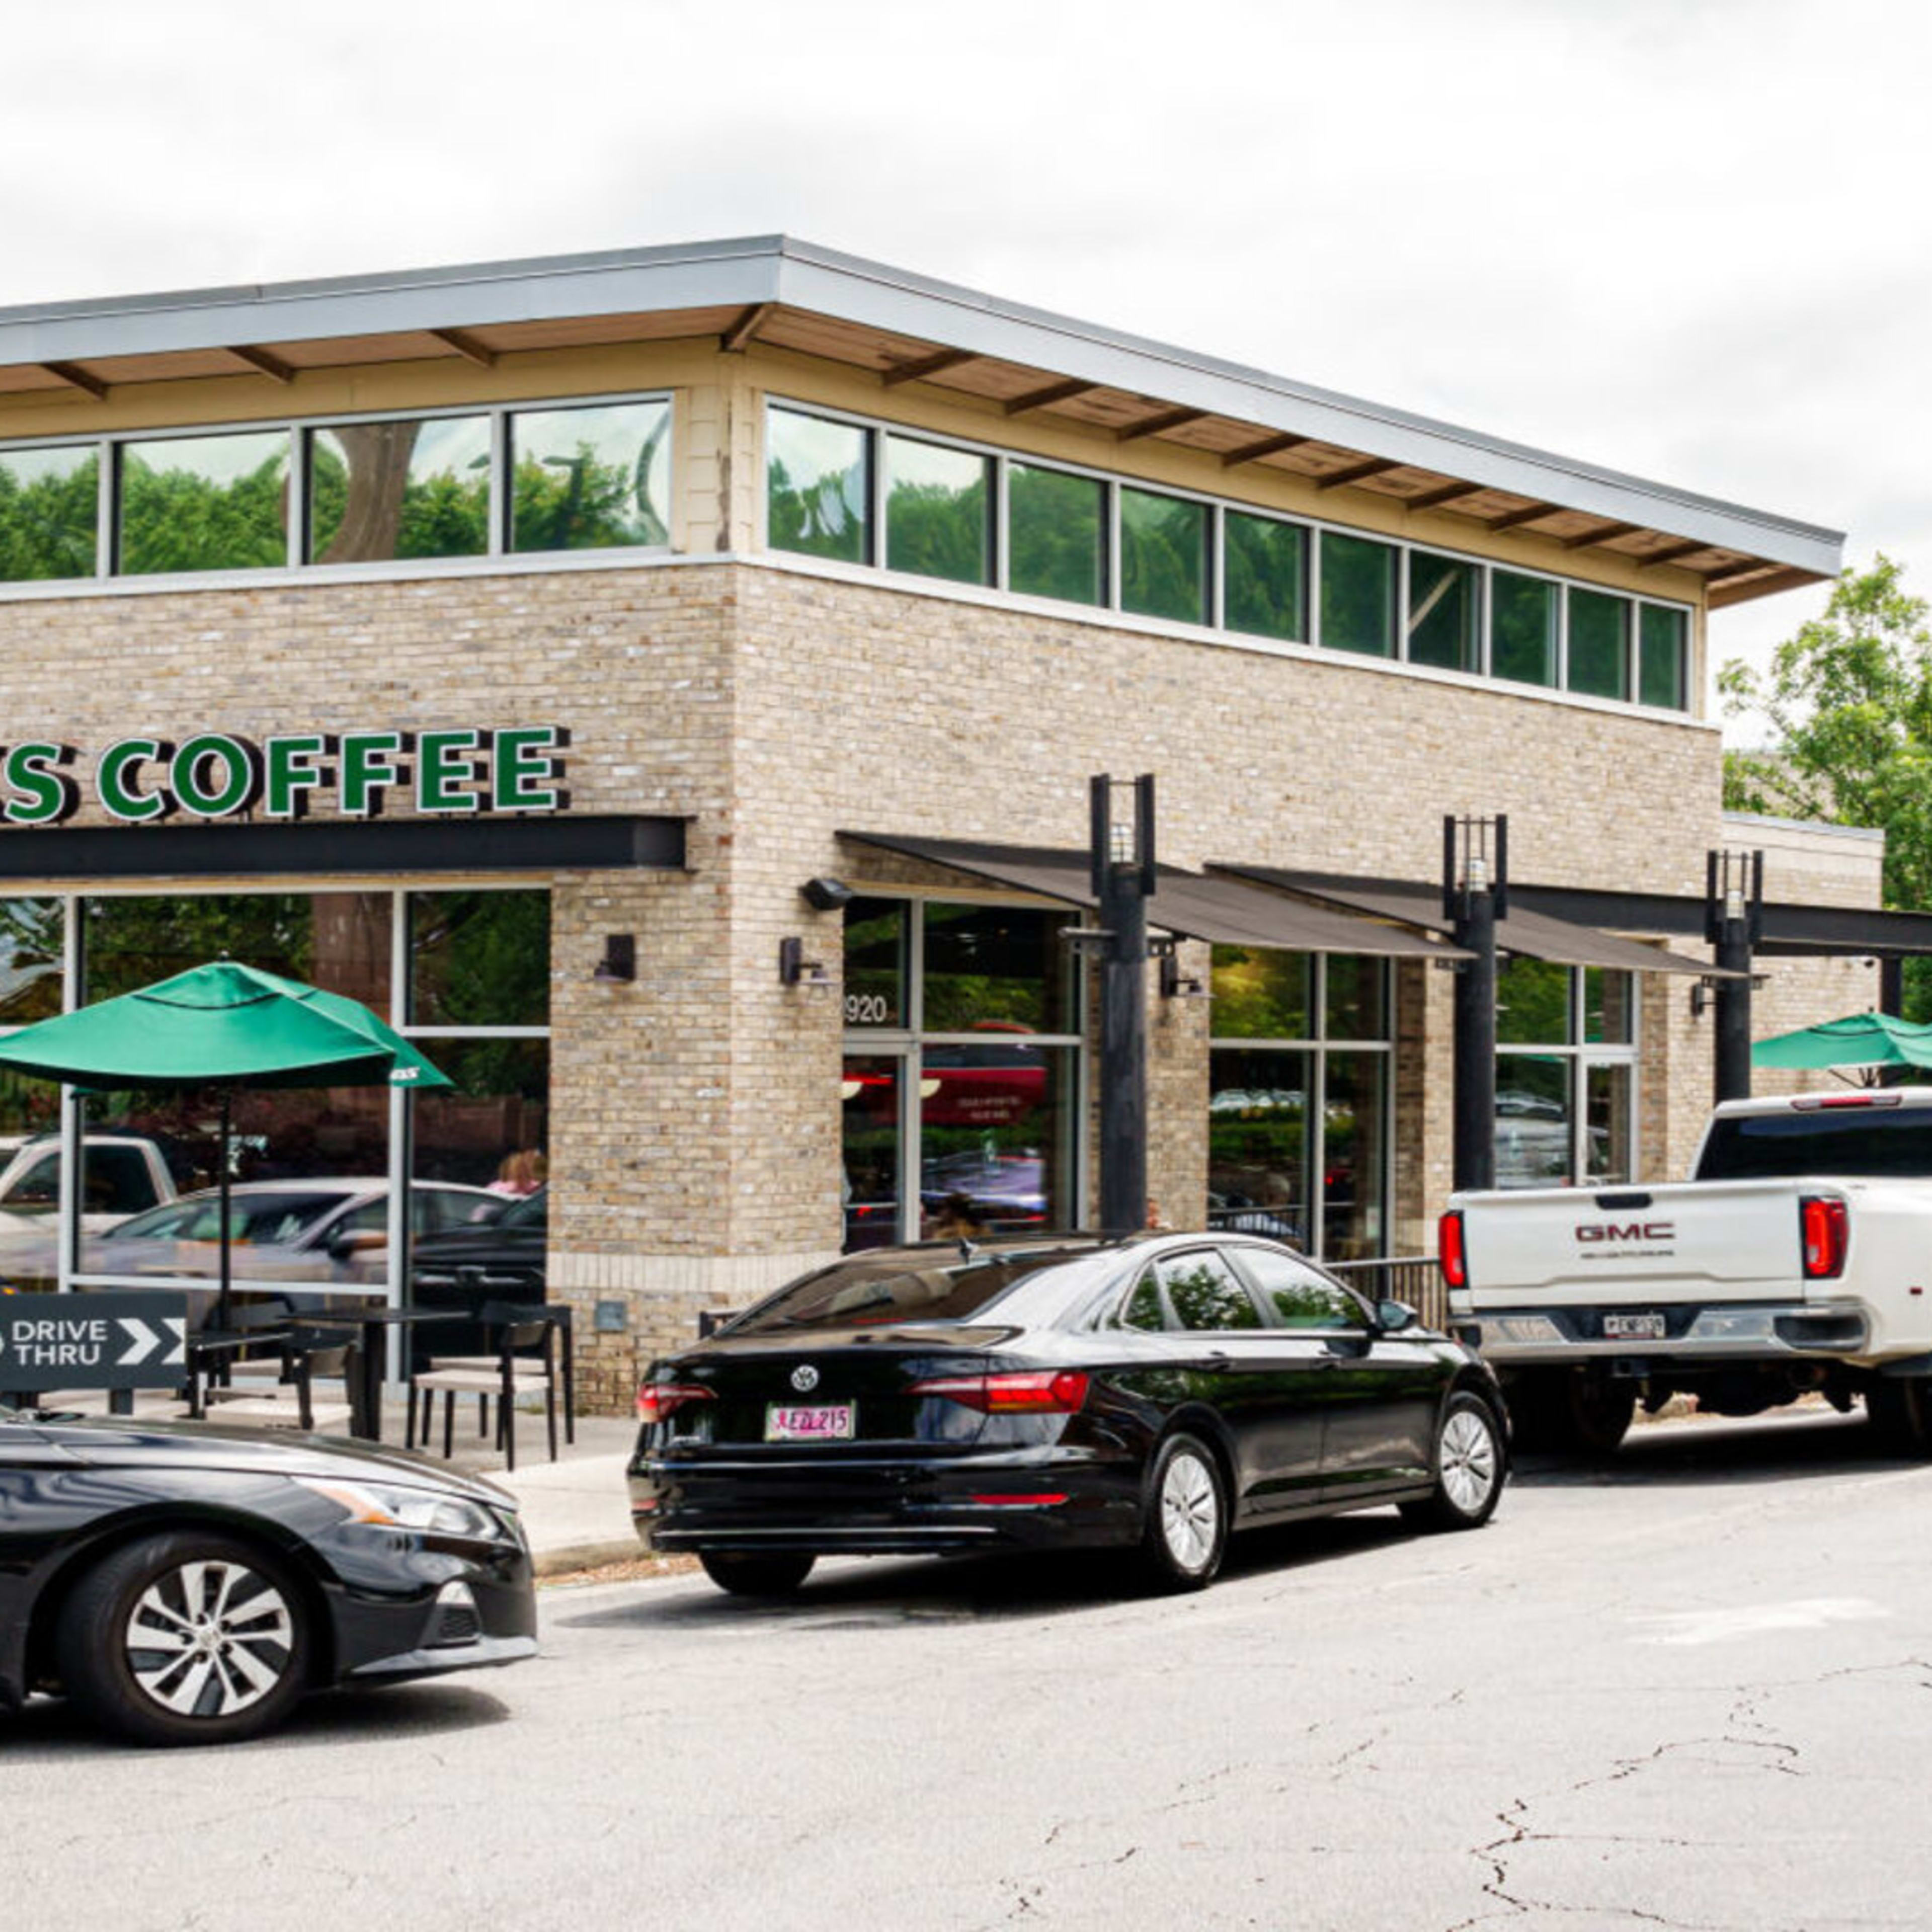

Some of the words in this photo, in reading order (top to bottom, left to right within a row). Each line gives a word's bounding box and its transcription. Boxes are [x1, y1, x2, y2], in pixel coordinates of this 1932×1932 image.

[98, 726, 558, 821] COFFEE
[1576, 1223, 1675, 1242] GMC
[12, 1320, 108, 1341] DRIVE
[14, 1344, 100, 1365] THRU
